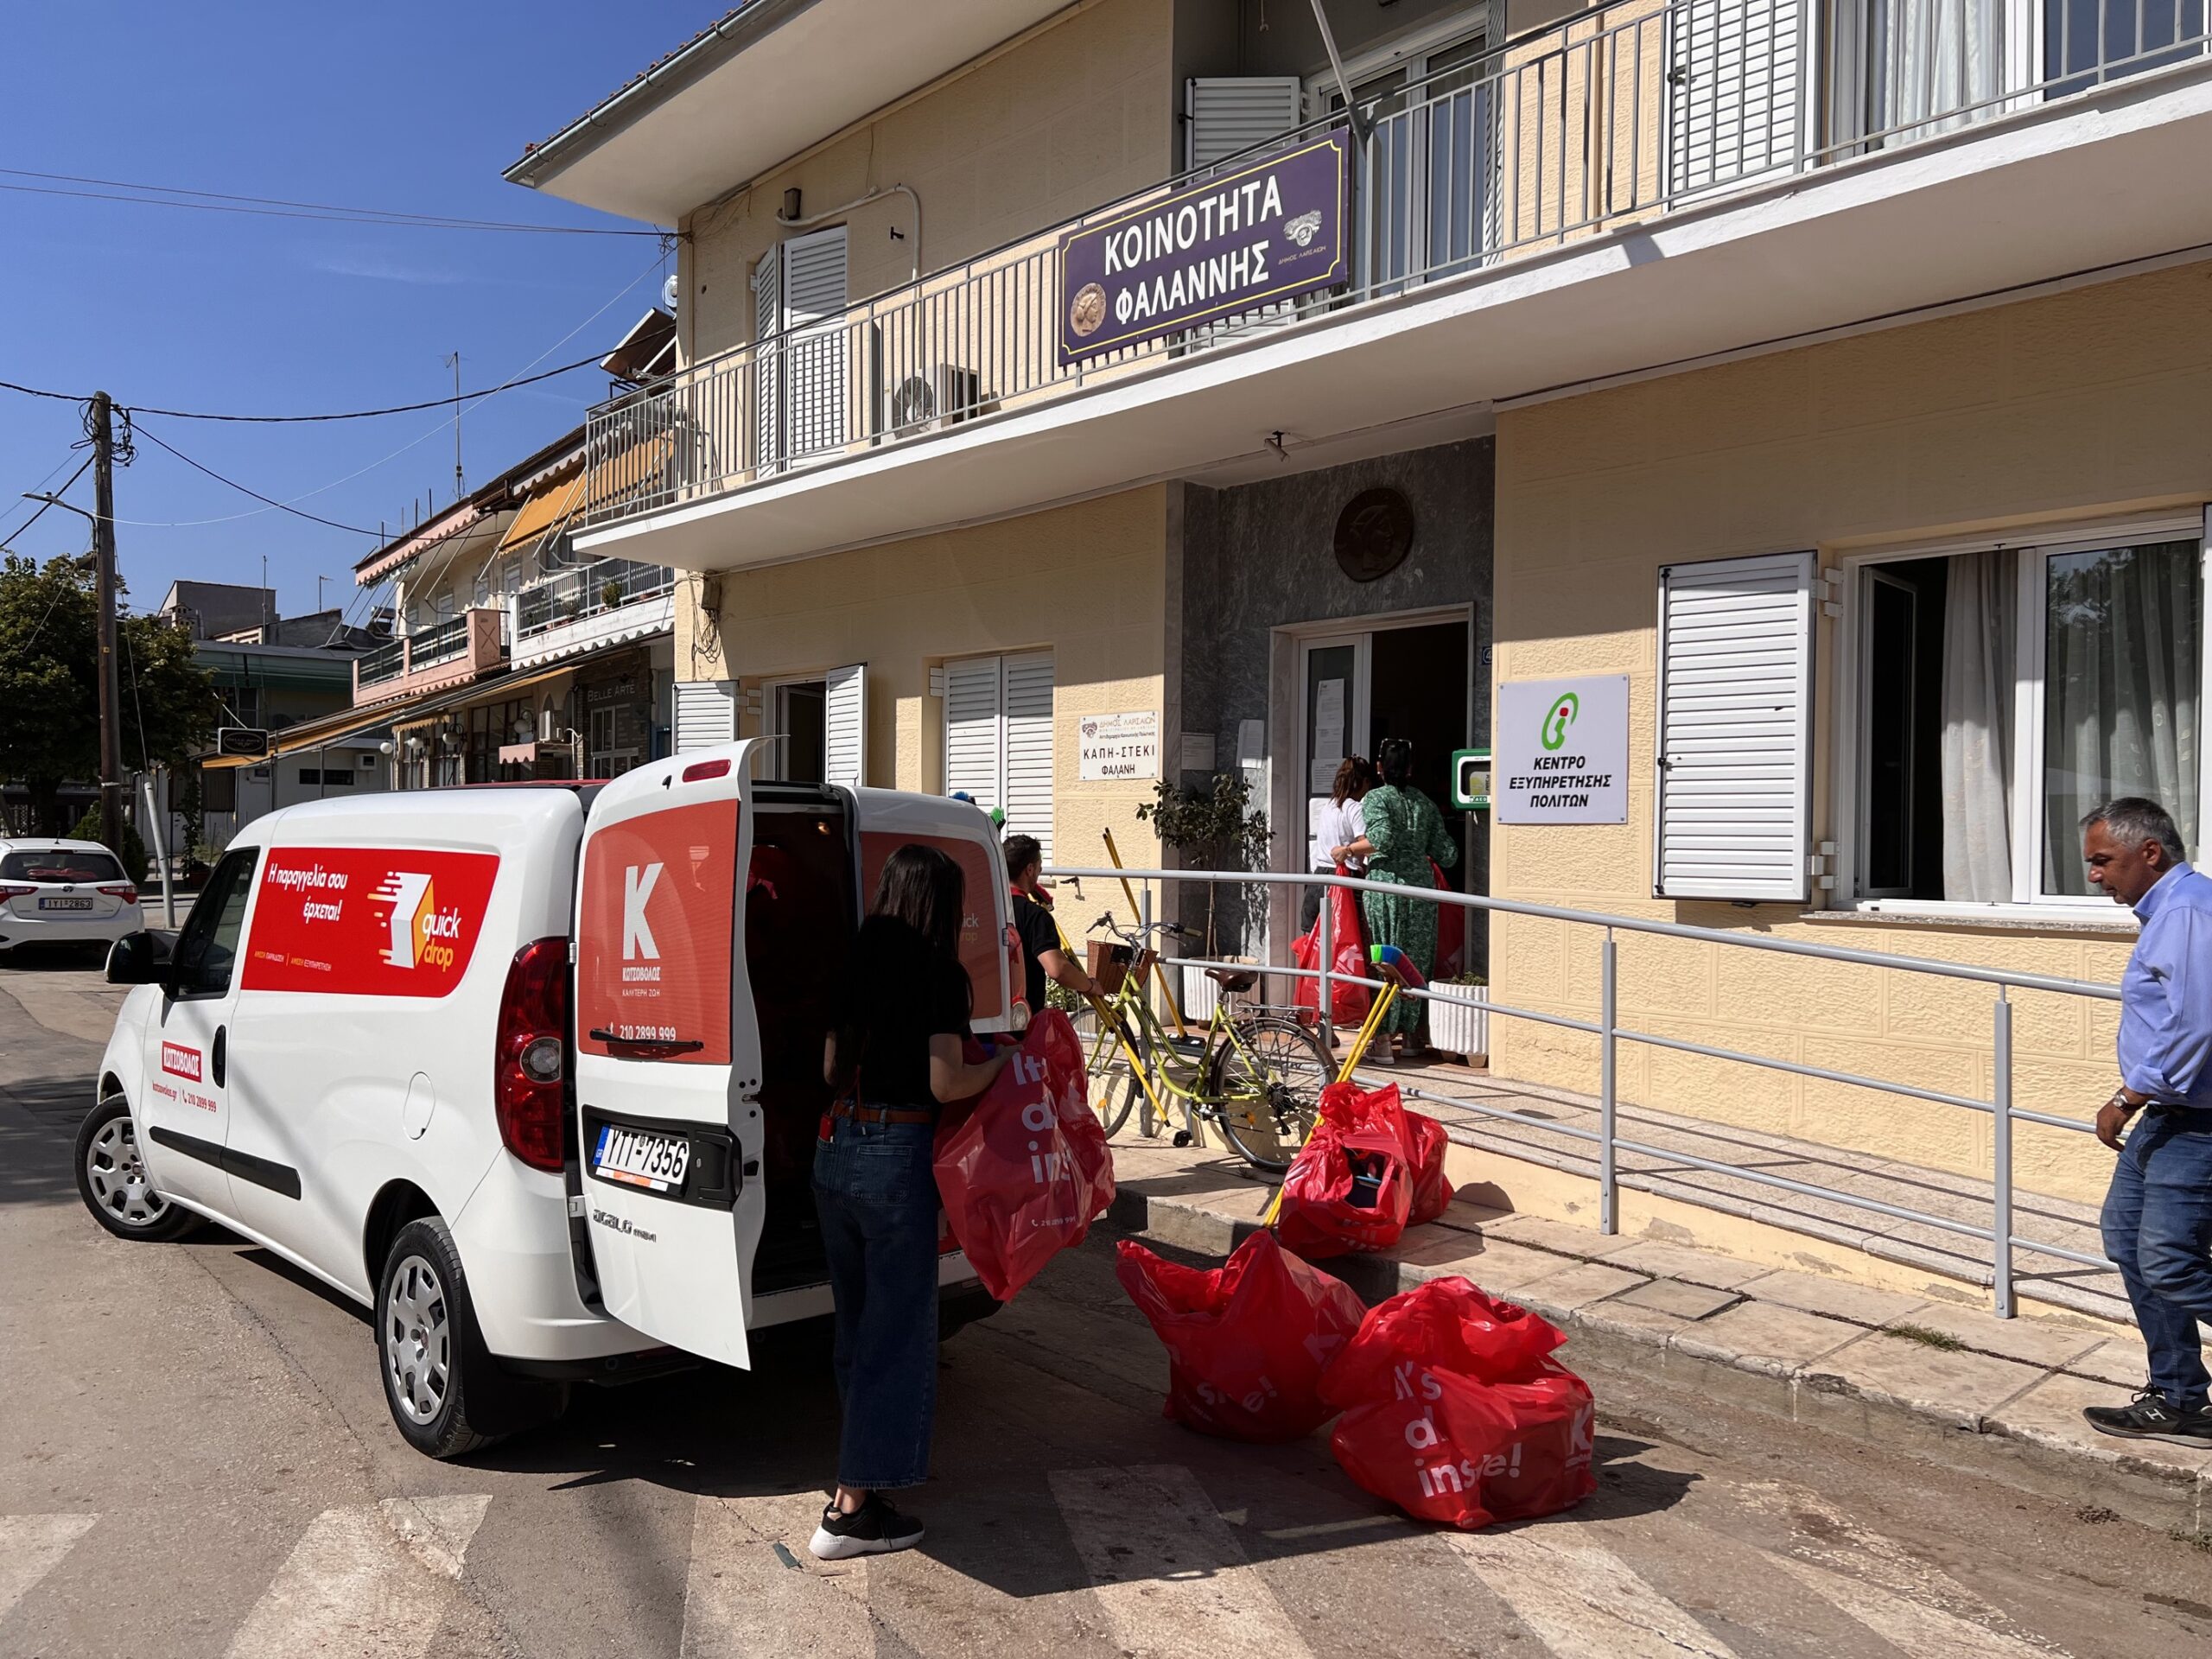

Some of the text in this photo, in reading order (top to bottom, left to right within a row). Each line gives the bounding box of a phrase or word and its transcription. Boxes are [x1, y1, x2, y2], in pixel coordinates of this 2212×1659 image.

[1105, 175, 1283, 276] ΚΟΙΝΟΤΗΤΑ
[1116, 240, 1270, 325] ΦΑΛΑΝΝΗΣ
[1102, 764, 1135, 775] ΦΑΛΑΝΗ
[1534, 756, 1586, 770] ΚΕΝΤΡΟ
[1509, 774, 1611, 790] ΕΞΥΠΗΡΕΤΗΣΗΣ
[1529, 794, 1589, 807] ΠΟΛΙΤΩΝ
[268, 862, 348, 892] Η παραγγελία σου
[303, 895, 343, 924] έρχεται!
[422, 906, 462, 942] quick
[423, 938, 454, 973] drop
[622, 966, 660, 982] ΚΩΤΣΟΒΟΛΟΣ
[620, 1025, 676, 1041] 210 2899 999
